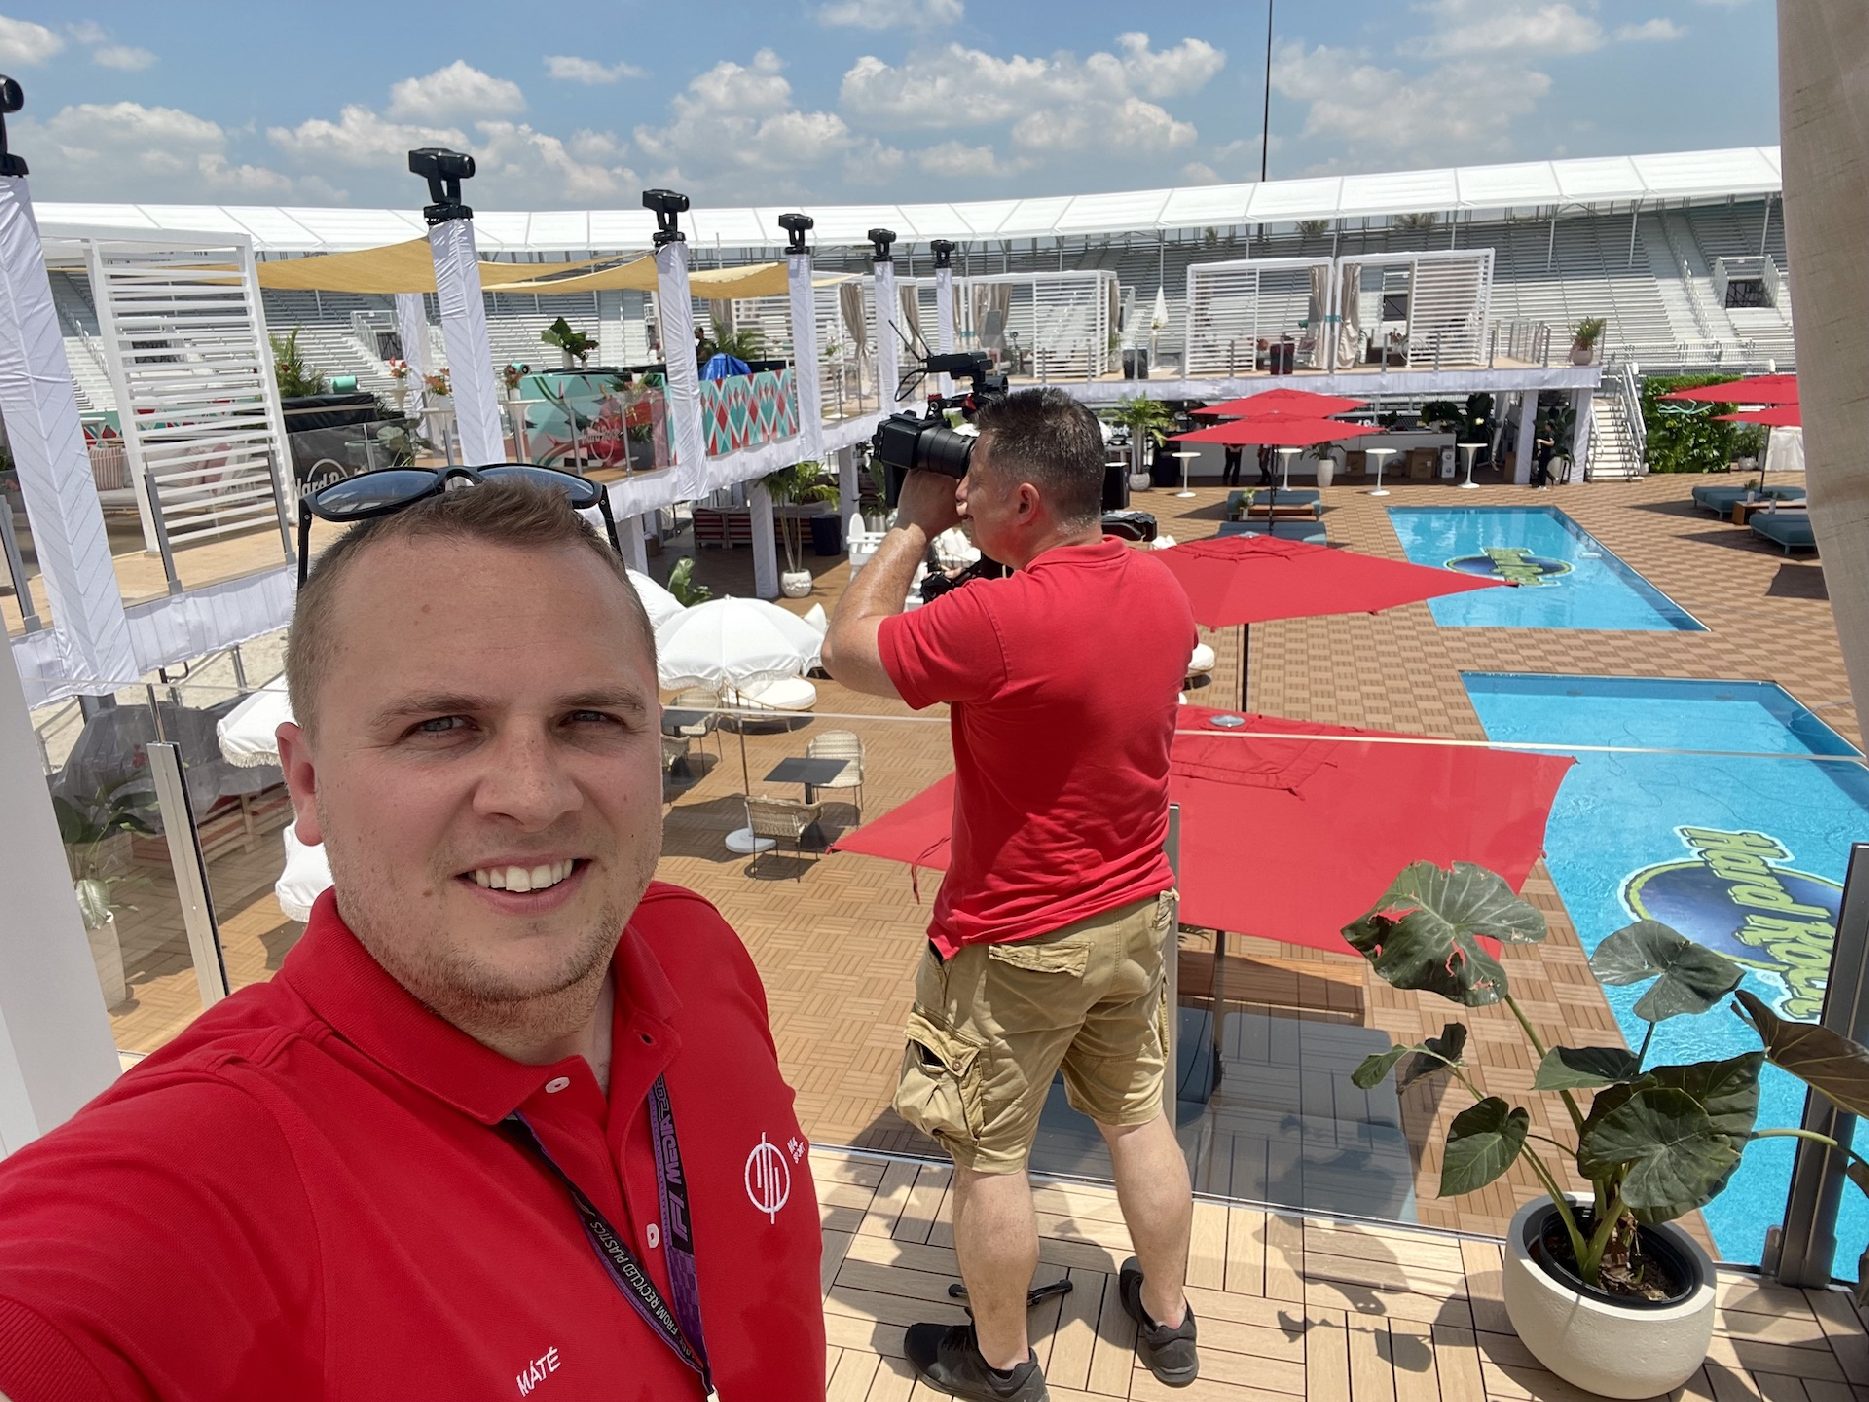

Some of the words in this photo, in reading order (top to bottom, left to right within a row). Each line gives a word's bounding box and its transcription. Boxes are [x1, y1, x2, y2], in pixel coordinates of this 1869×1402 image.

[1679, 827, 1832, 919] Hard
[660, 1114, 682, 1185] MEDIA
[590, 1221, 624, 1264] PLASTICS
[623, 1263, 661, 1308] RECYCLED
[657, 1305, 678, 1335] FROM
